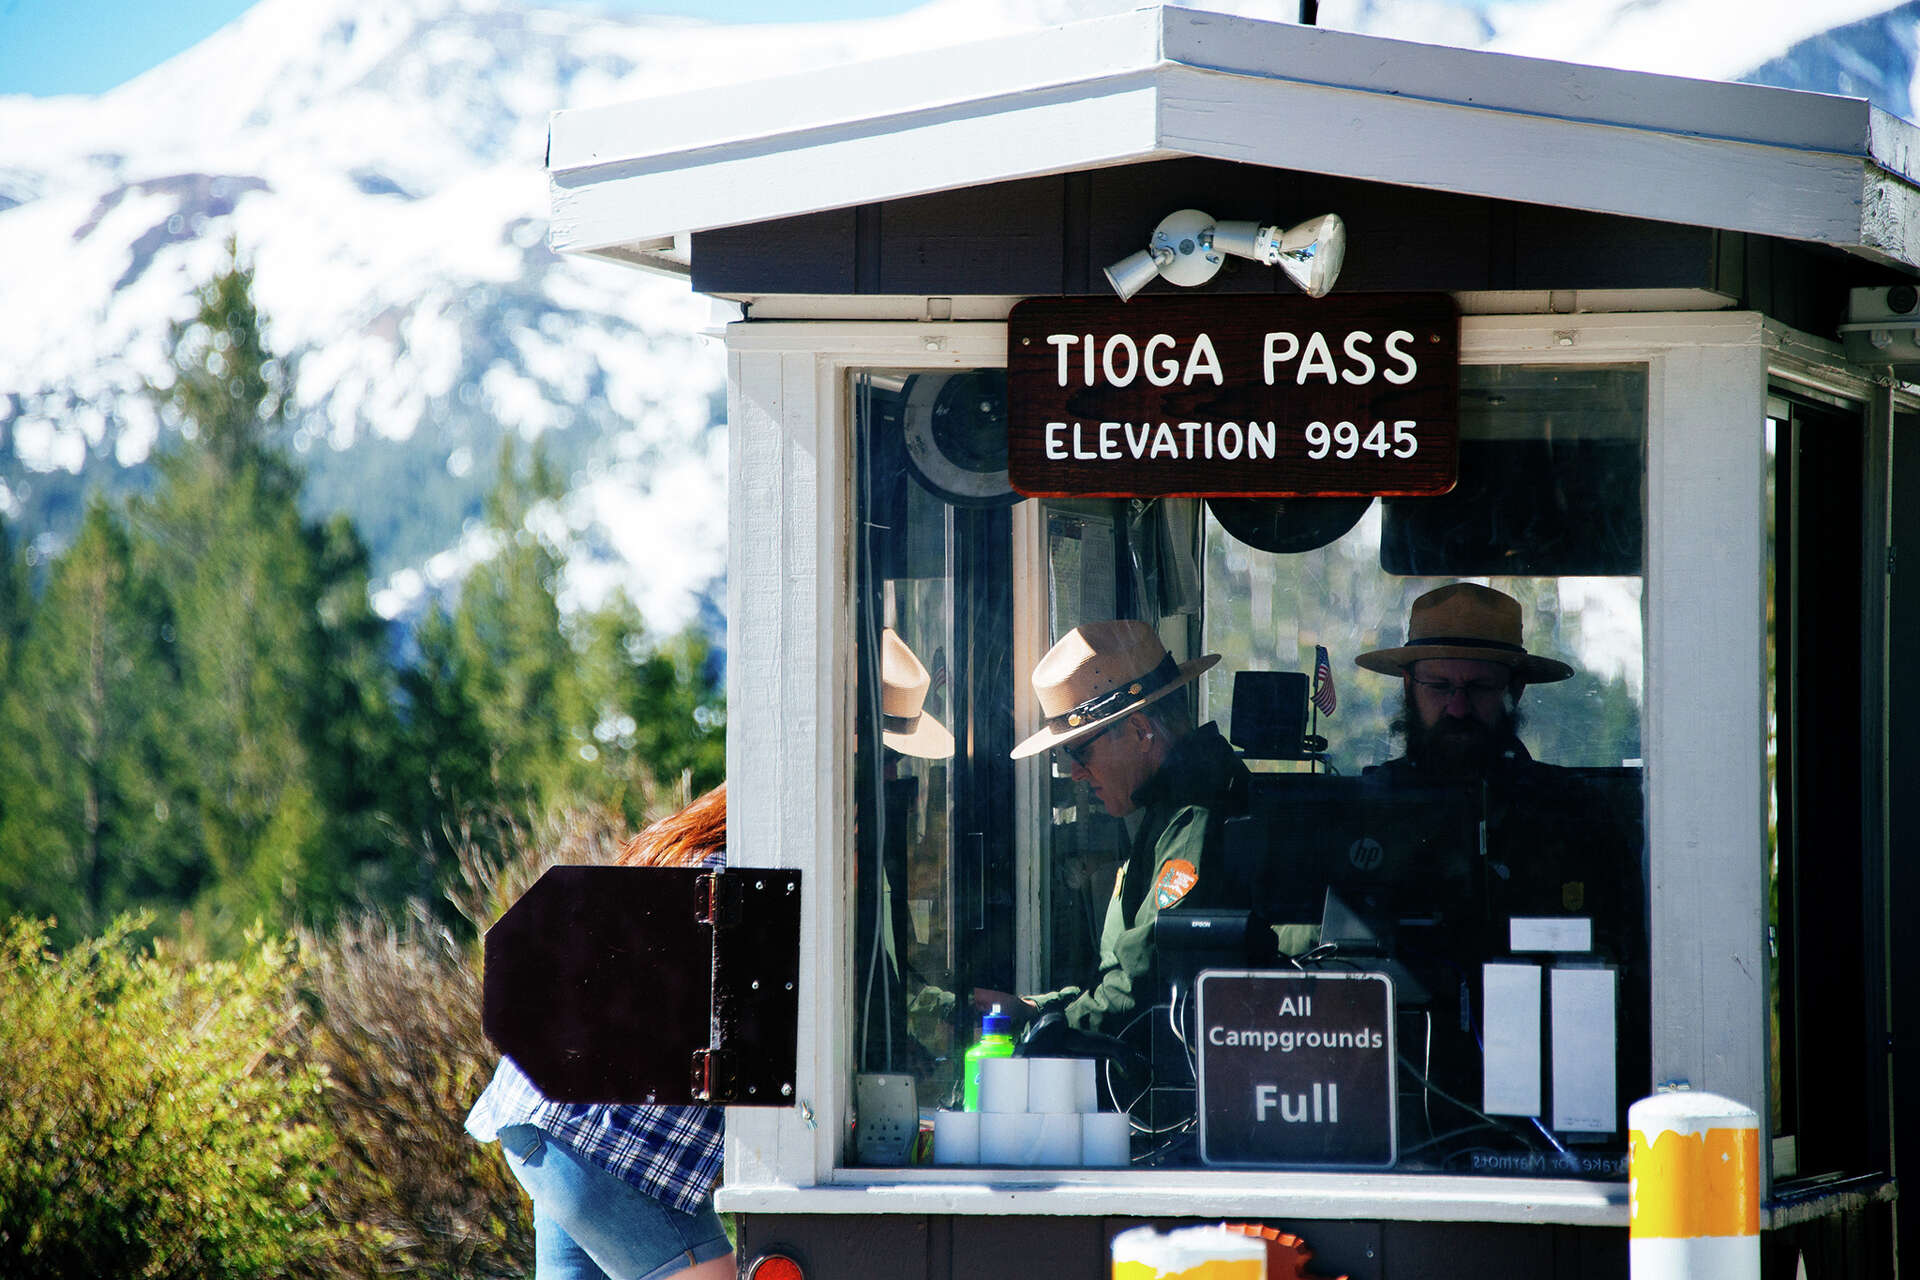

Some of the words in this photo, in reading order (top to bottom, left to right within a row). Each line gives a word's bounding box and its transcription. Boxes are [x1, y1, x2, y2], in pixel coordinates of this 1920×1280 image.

[1046, 333, 1224, 388] TIOGA
[1263, 330, 1417, 386] PASS
[1045, 421, 1276, 460] ELEVATION
[1305, 420, 1418, 460] 9945
[1278, 995, 1311, 1017] All
[1208, 1025, 1383, 1053] Campgrounds
[1255, 1082, 1338, 1123] Full
